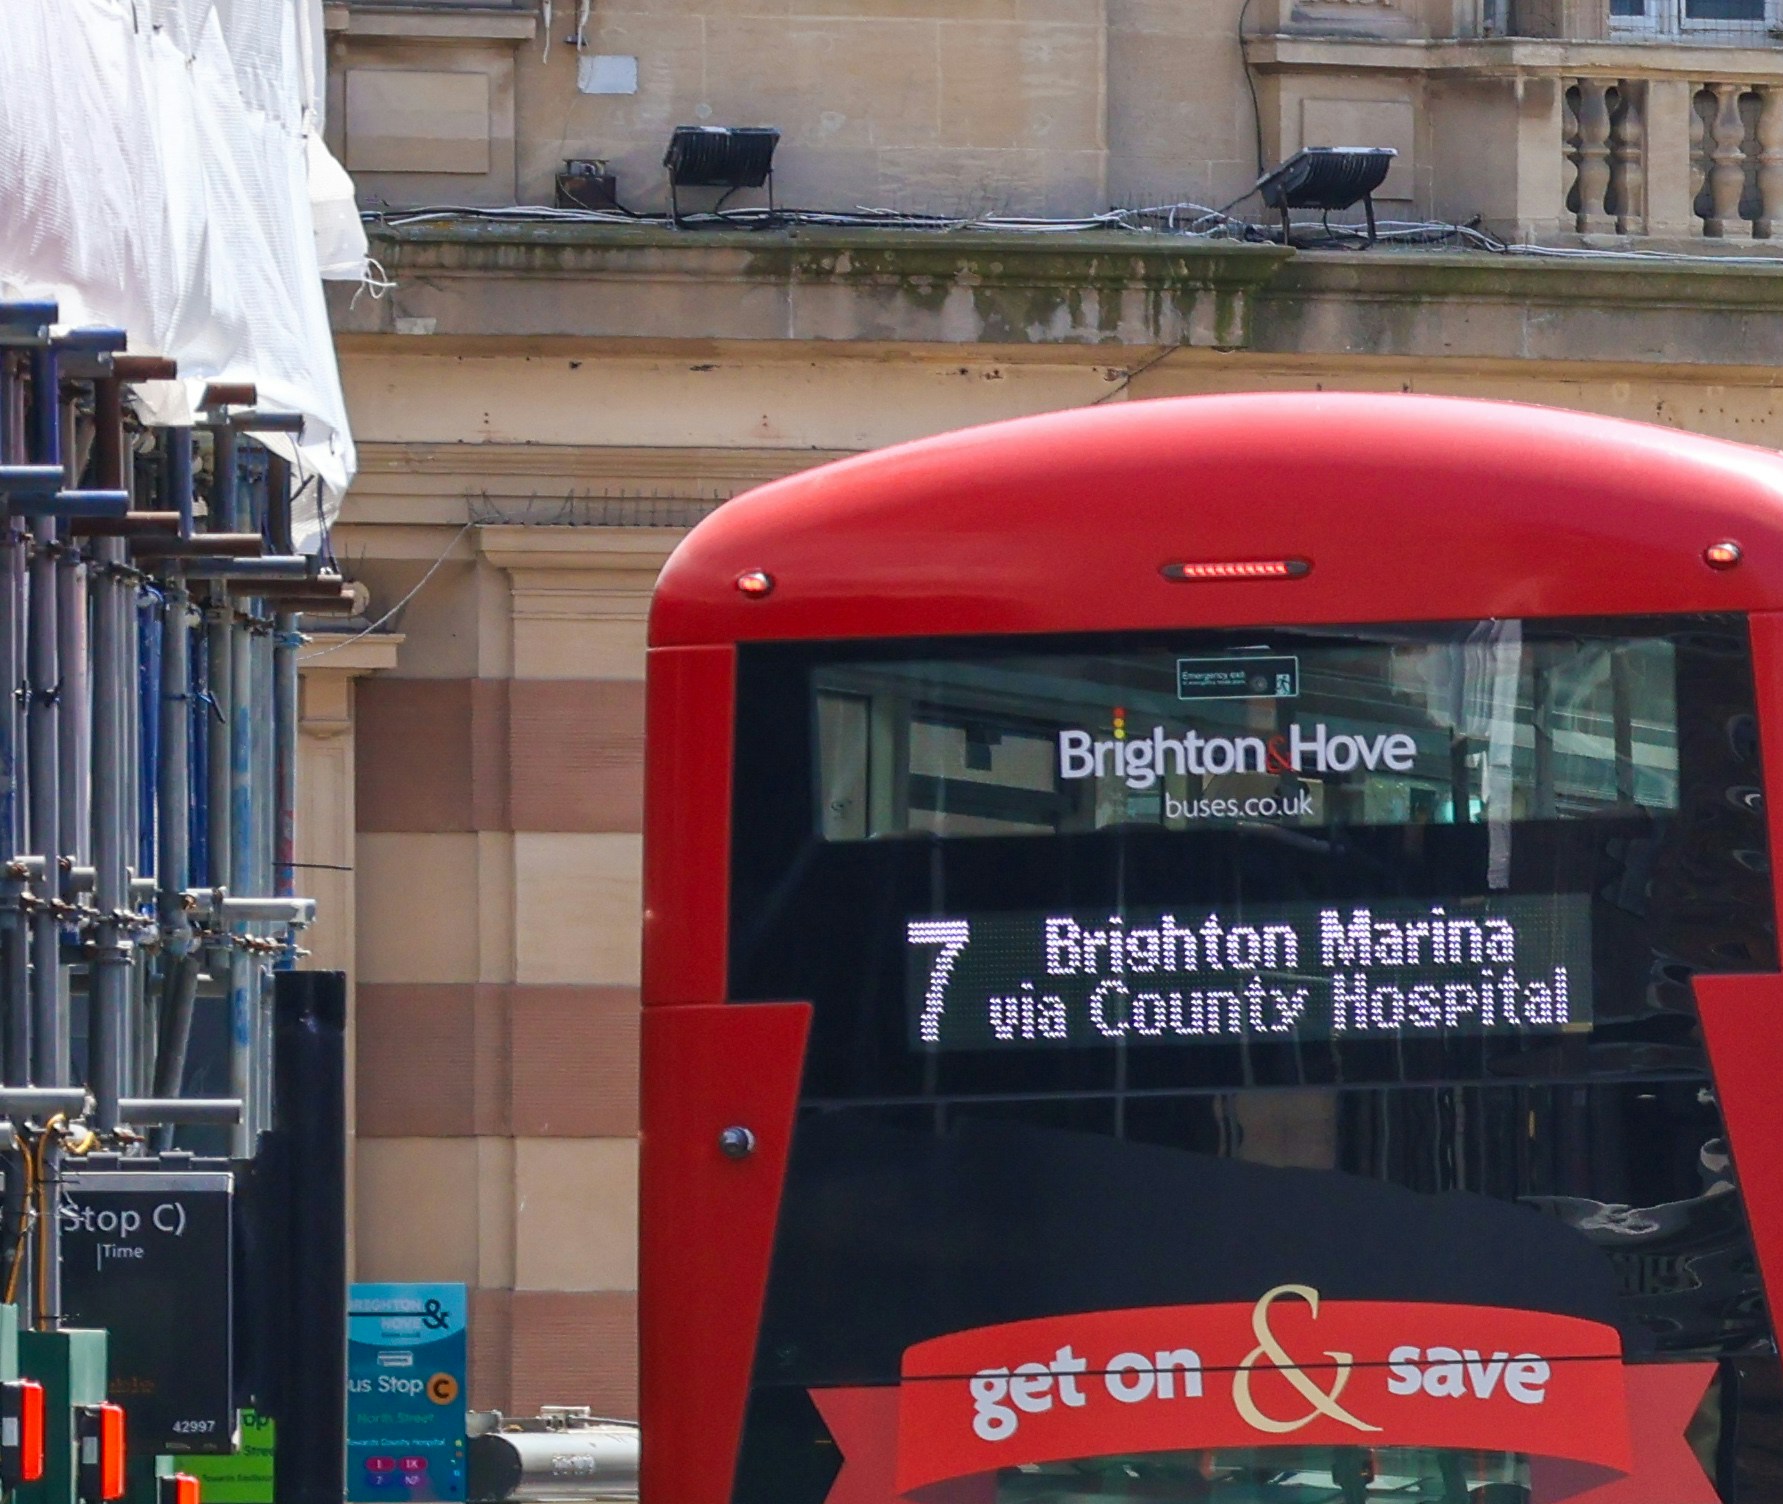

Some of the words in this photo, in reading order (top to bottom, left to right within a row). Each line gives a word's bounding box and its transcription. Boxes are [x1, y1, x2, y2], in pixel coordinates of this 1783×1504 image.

[1165, 789, 1314, 819] buses.co.uk
[1046, 912, 1297, 974] Brighton
[1321, 907, 1516, 968] Marina
[906, 920, 970, 1041] 7
[990, 981, 1066, 1039] via
[1089, 976, 1309, 1037] County
[1333, 966, 1570, 1030] Hospital
[153, 1203, 187, 1236] C)
[103, 1244, 144, 1259] Time
[969, 1345, 1086, 1442] get
[1104, 1347, 1203, 1403] on
[1232, 1283, 1384, 1434] &
[1386, 1346, 1551, 1405] save
[348, 1380, 372, 1392] us
[378, 1375, 424, 1396] Stop
[172, 1421, 215, 1433] 42997
